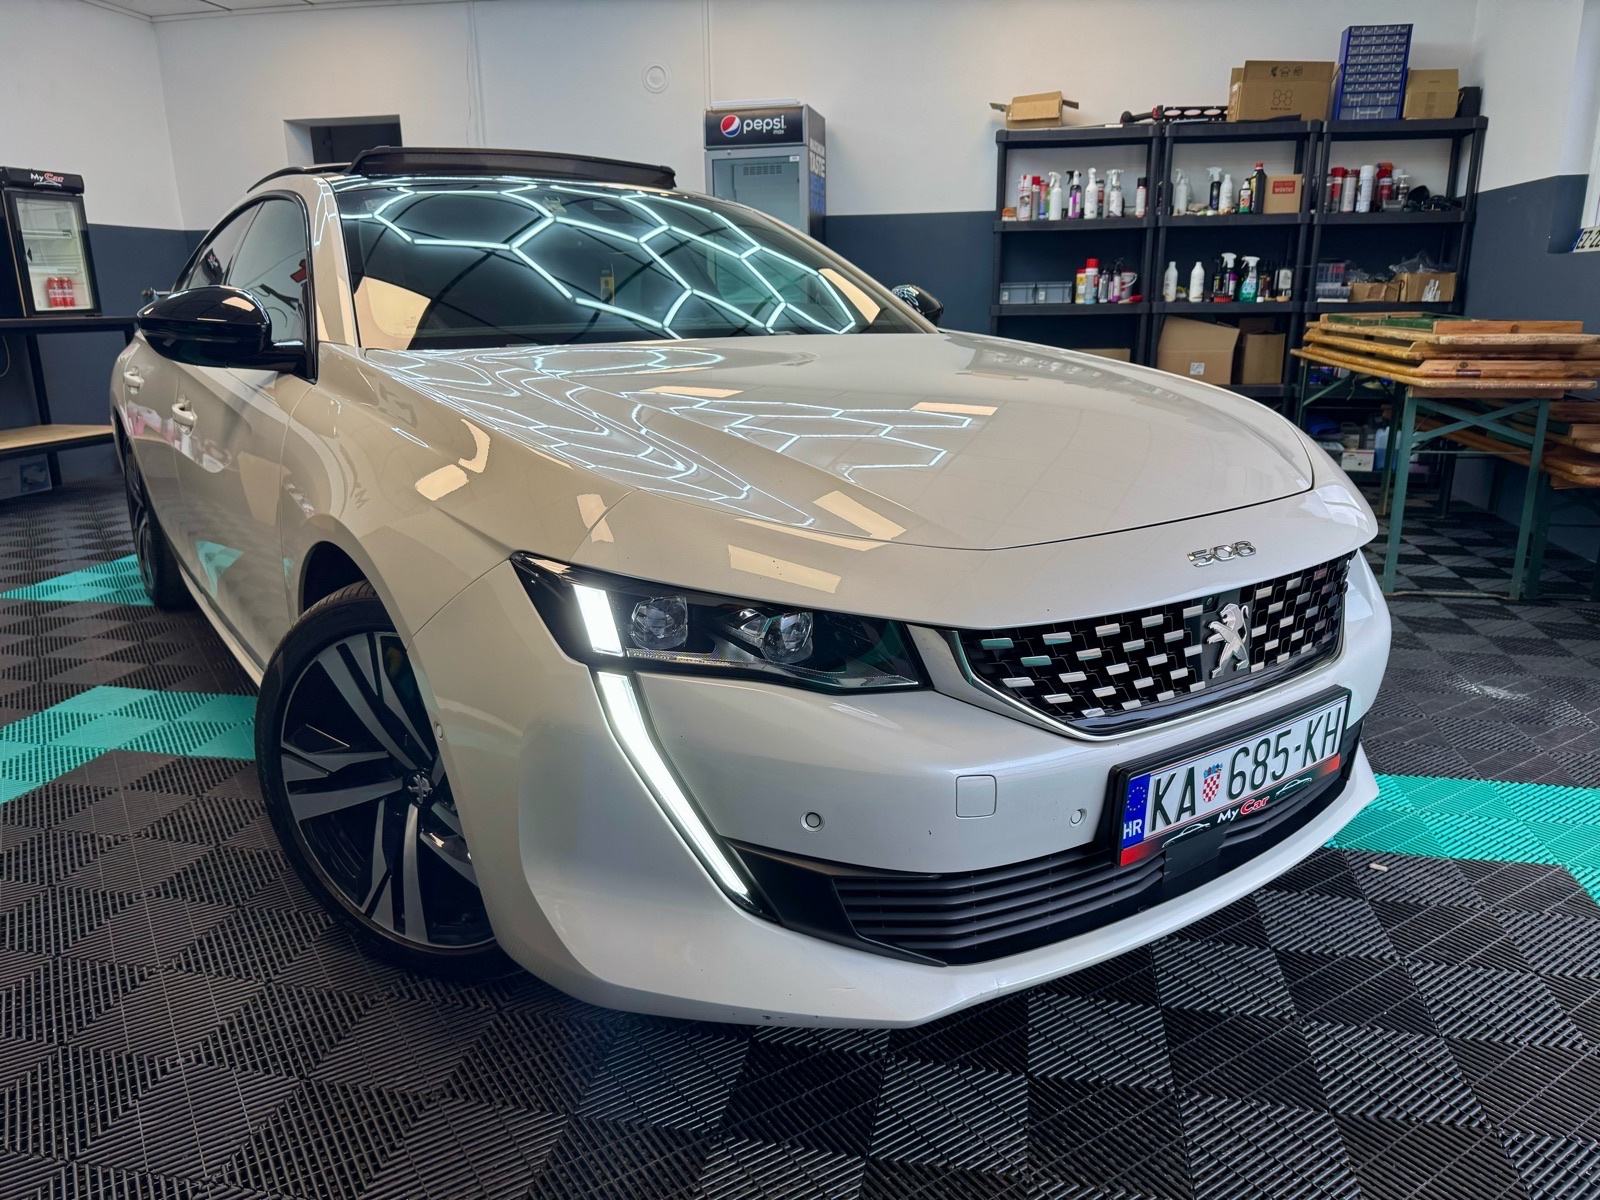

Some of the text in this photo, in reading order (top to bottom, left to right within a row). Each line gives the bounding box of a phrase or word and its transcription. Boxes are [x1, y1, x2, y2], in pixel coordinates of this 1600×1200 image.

[743, 114, 785, 134] pepsi
[30, 172, 65, 182] My Car
[1151, 706, 1343, 832] KA 685-KH
[1217, 796, 1270, 824] My Car
[1122, 818, 1142, 840] HR
